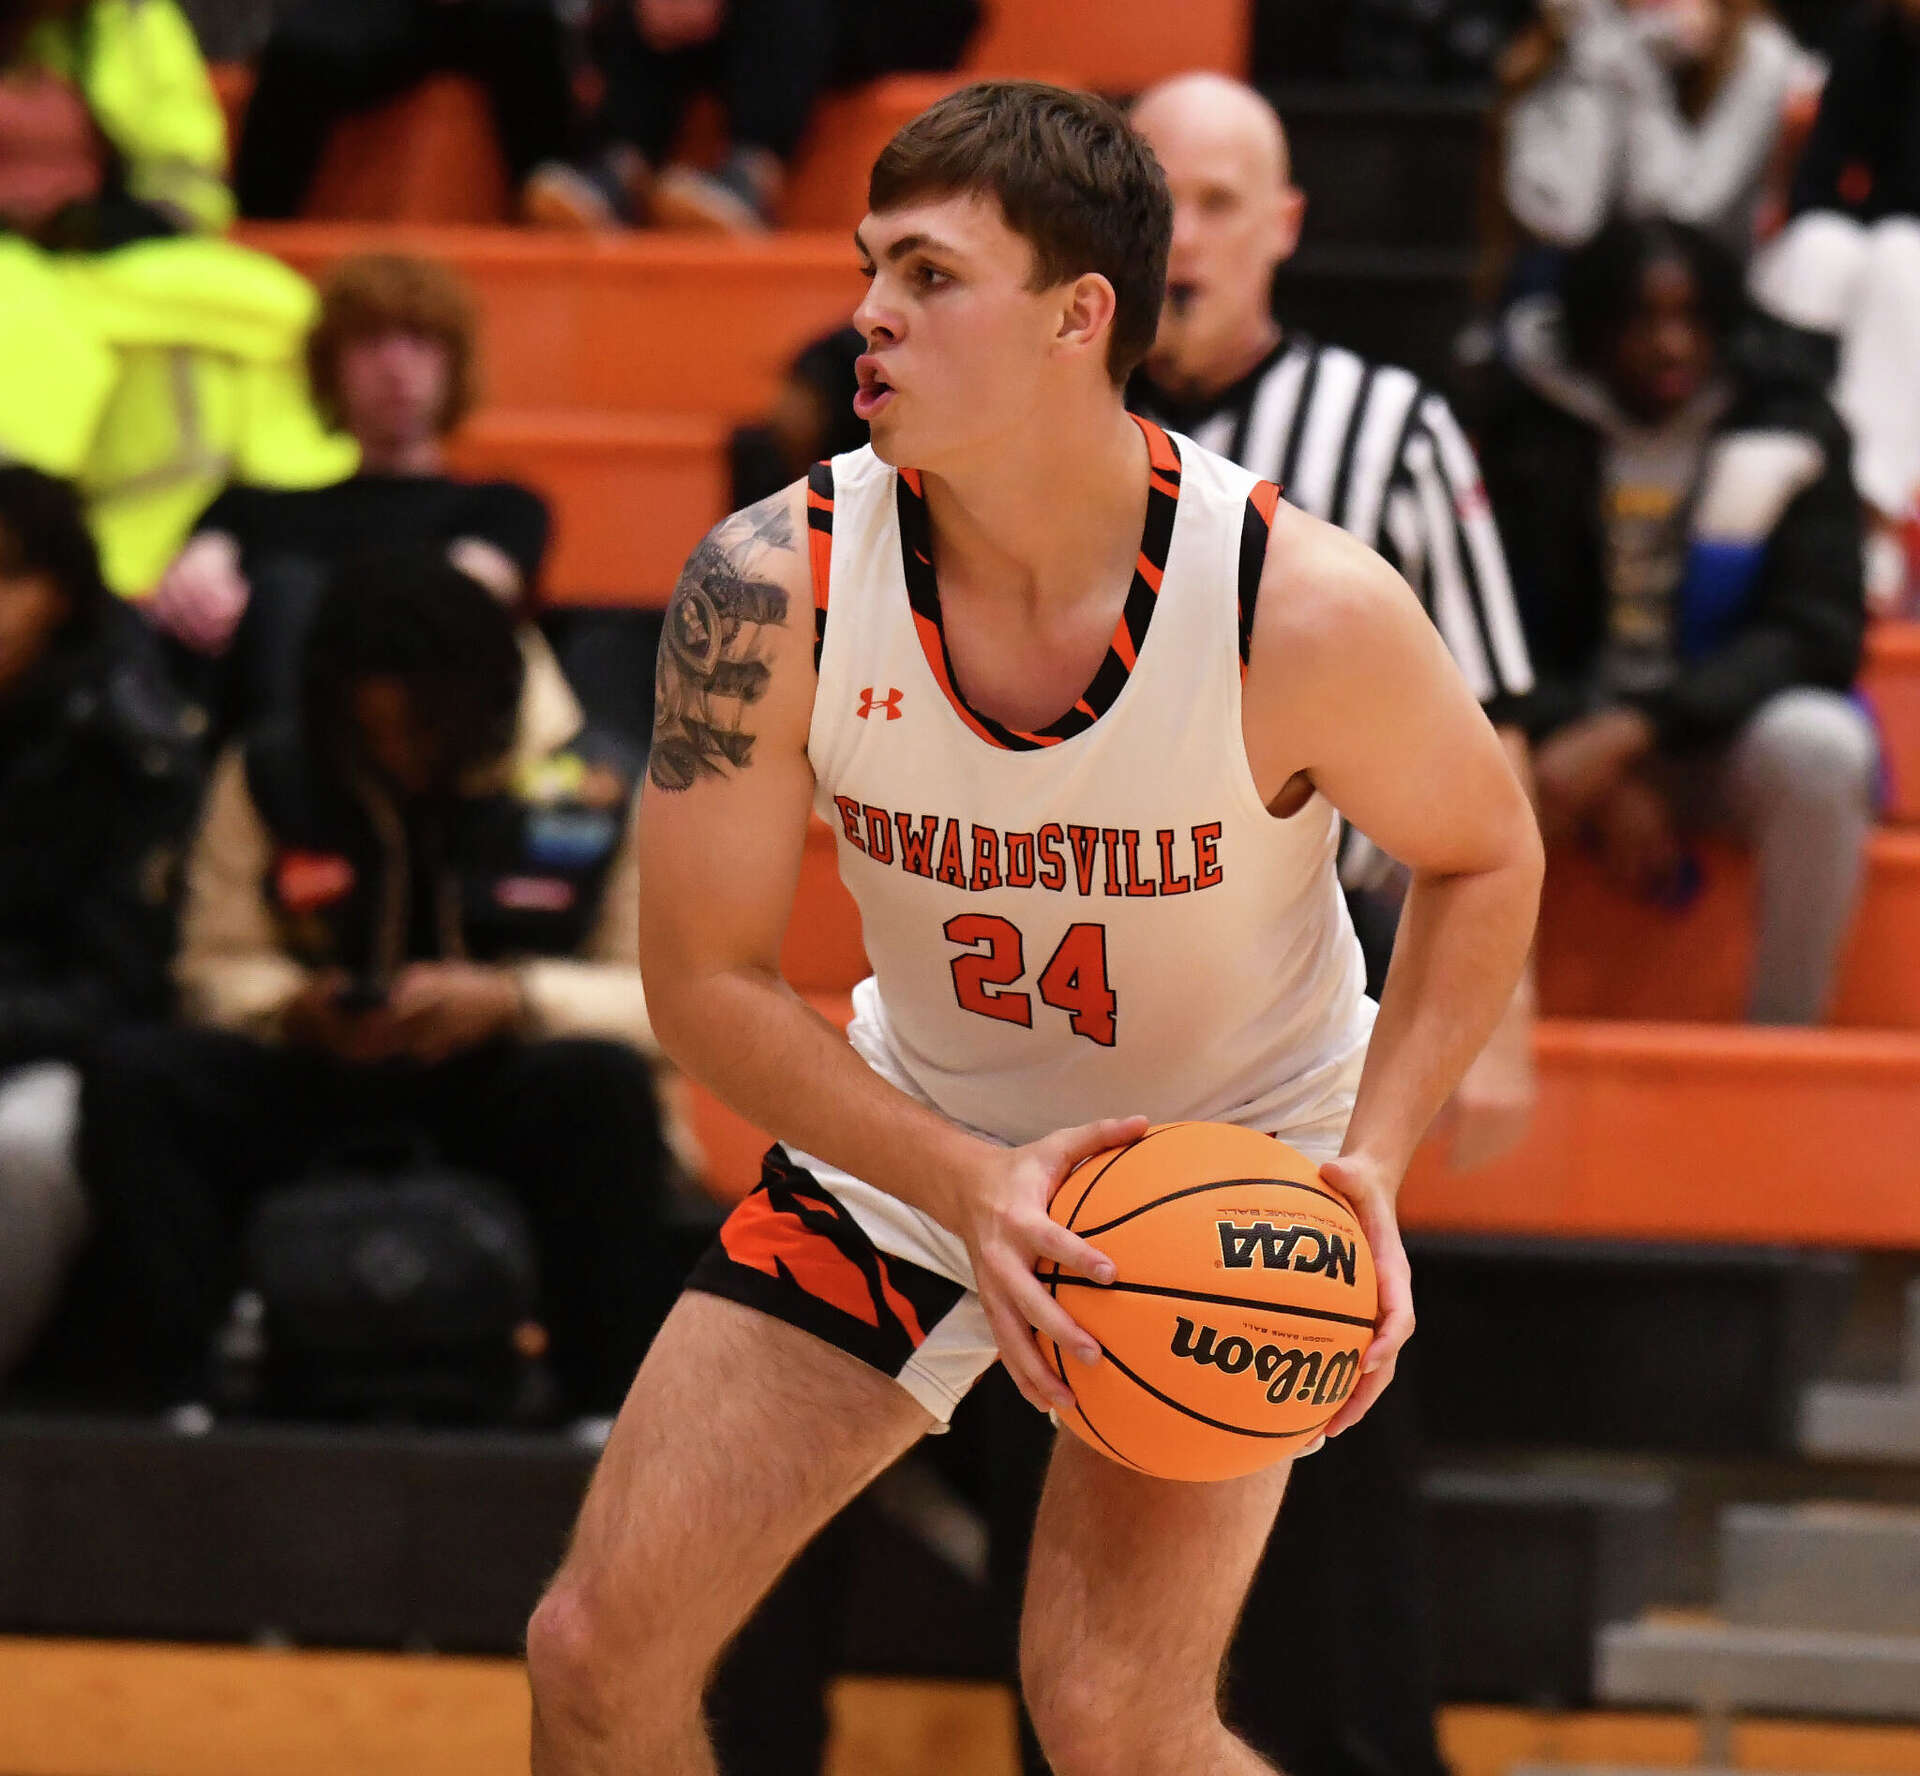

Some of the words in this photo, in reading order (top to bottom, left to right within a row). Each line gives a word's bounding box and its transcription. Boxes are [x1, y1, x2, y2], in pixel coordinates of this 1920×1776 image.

[834, 795, 1224, 897] EDWARDSVILLE
[942, 913, 1118, 1048] 24
[1215, 1208, 1260, 1217] BALL
[1216, 1220, 1357, 1287] NCAA
[1170, 1315, 1360, 1406] Wilson
[1242, 1321, 1268, 1334] BALL
